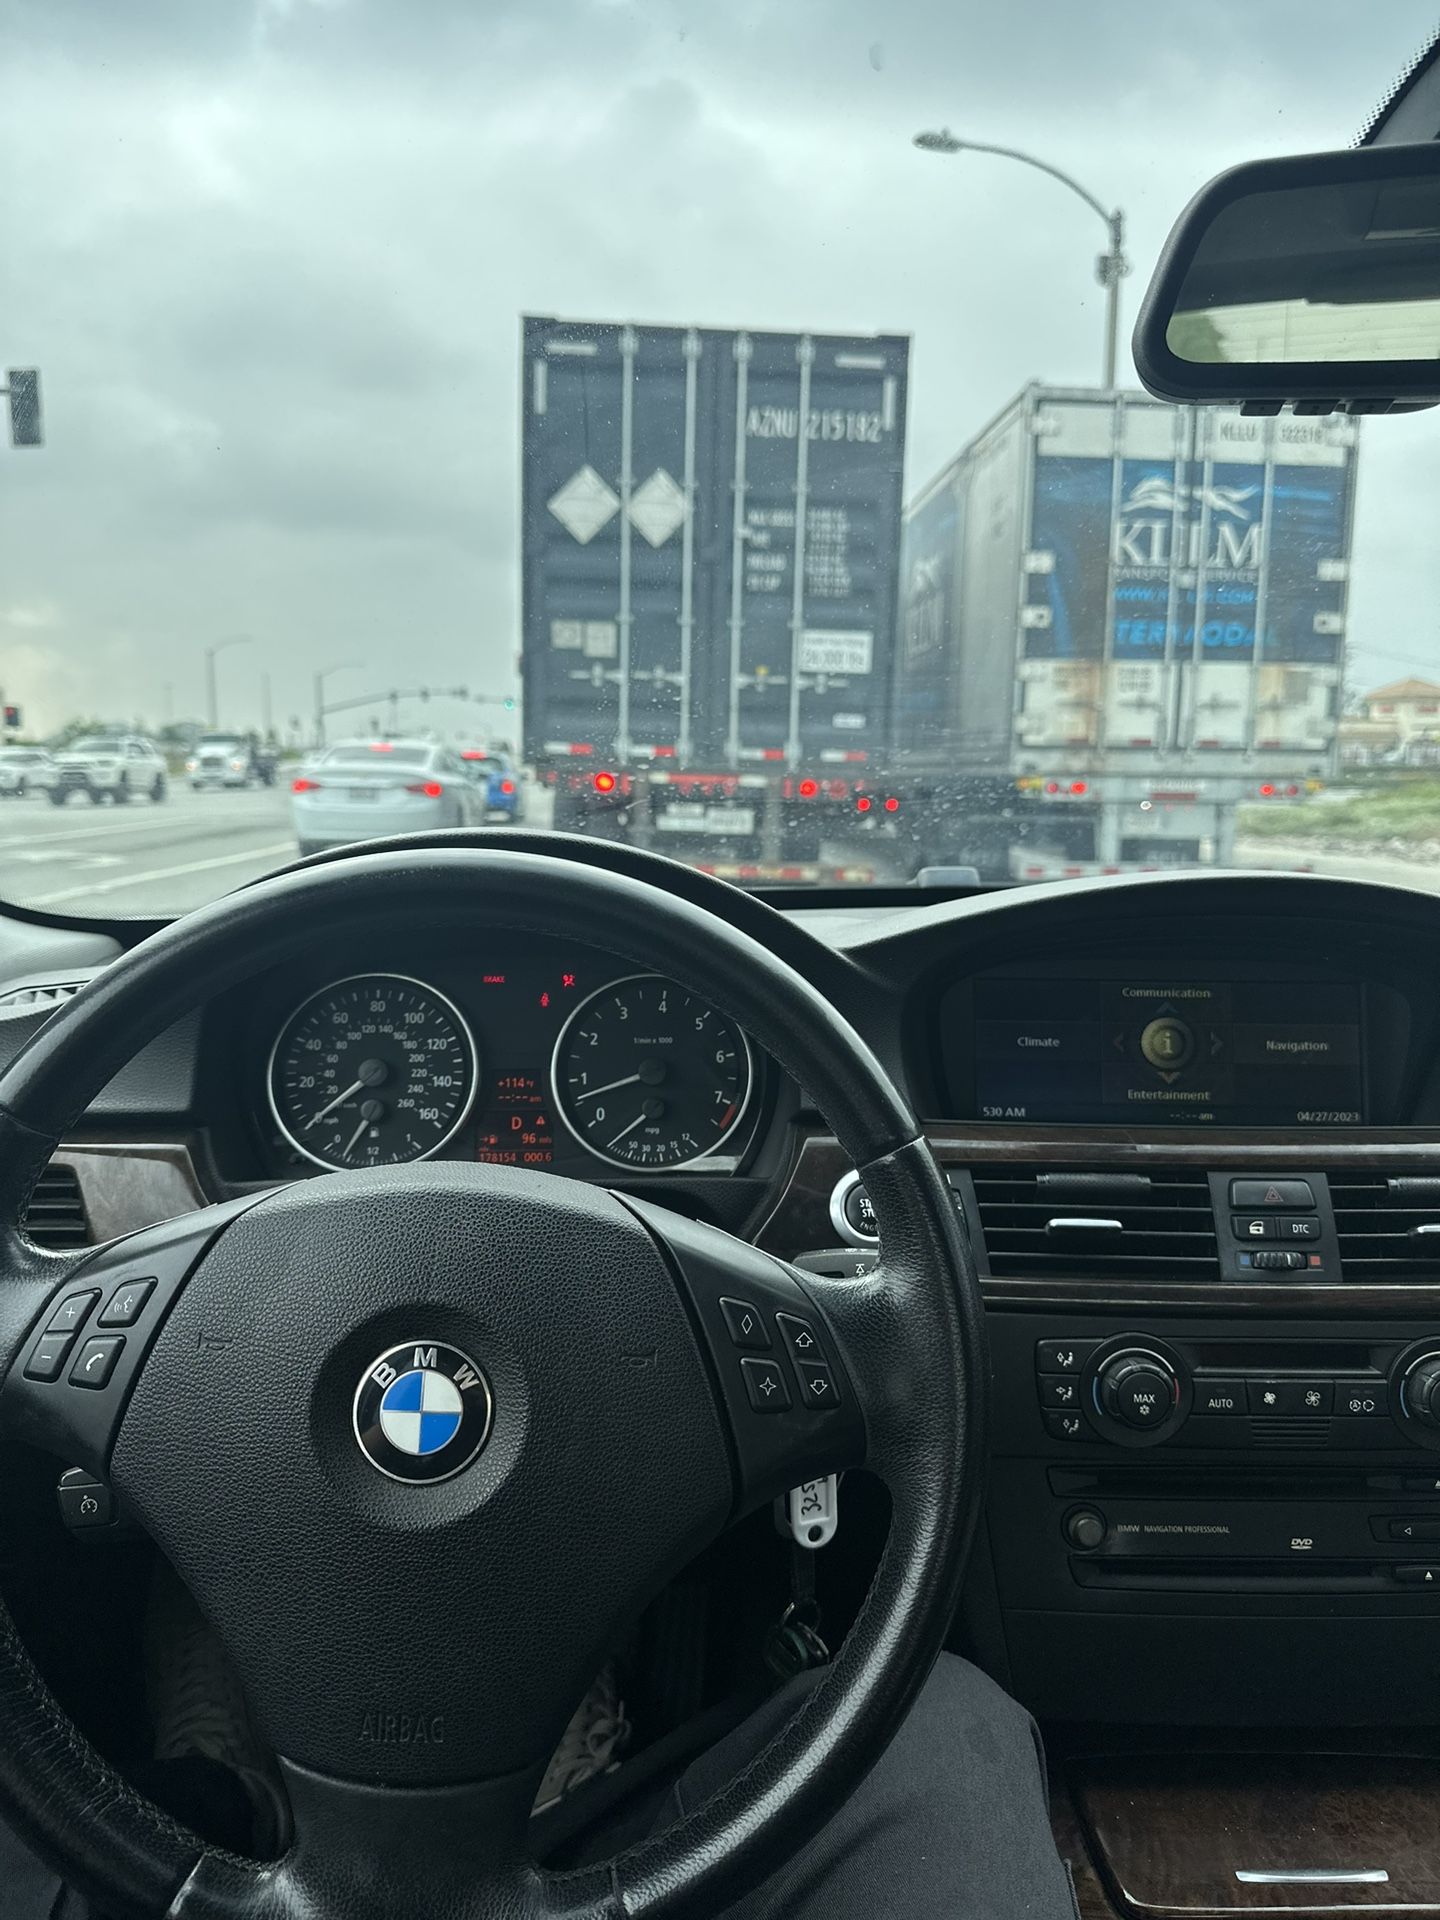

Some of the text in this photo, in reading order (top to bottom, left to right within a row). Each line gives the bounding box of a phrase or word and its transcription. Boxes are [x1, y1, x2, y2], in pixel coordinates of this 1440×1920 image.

[746, 405, 797, 438] AZNU
[1122, 987, 1211, 998] Communication
[370, 1001, 385, 1012] 80
[658, 1001, 667, 1013] 4
[333, 1013, 348, 1024] 60
[404, 1013, 424, 1024] 100
[620, 1007, 628, 1019] 3
[361, 1025, 376, 1034] 120
[379, 1025, 393, 1034] 140
[695, 1018, 703, 1030] 5
[348, 1032, 362, 1041] 100
[393, 1032, 407, 1040] 160
[590, 1033, 598, 1045] 2
[305, 1039, 322, 1051] 40
[336, 1041, 347, 1050] 80
[402, 1040, 417, 1049] 180
[427, 1038, 447, 1050] 120
[1017, 1036, 1060, 1048] Climate
[1266, 1039, 1329, 1053] Navigation
[327, 1054, 338, 1063] 60
[409, 1054, 425, 1063] 200
[716, 1051, 724, 1063] 6
[323, 1069, 335, 1078] 40
[411, 1069, 427, 1078] 220
[581, 1073, 587, 1085] 1
[300, 1076, 315, 1088] 20
[433, 1075, 452, 1087] 140
[327, 1085, 338, 1094] 20
[408, 1085, 424, 1094] 240
[1127, 1089, 1211, 1101] Entertainment
[715, 1091, 723, 1103] 7
[397, 1099, 414, 1108] 260
[419, 1108, 439, 1120] 160
[596, 1108, 605, 1120] 0
[1004, 1107, 1026, 1117] AM
[1296, 1111, 1360, 1123] 04/27/2023
[511, 1116, 522, 1130] D
[645, 1127, 660, 1136] mpg
[334, 1135, 341, 1143] 0
[522, 1133, 536, 1144] 96
[682, 1134, 690, 1142] 12
[367, 1146, 379, 1155] 1/2
[629, 1141, 638, 1149] 50
[642, 1144, 651, 1152] 30
[656, 1144, 665, 1152] 20
[670, 1141, 678, 1149] 15
[1292, 1223, 1310, 1235] DTC
[371, 1346, 480, 1391] BMW
[1133, 1393, 1156, 1404] MAX
[1207, 1397, 1234, 1409] AUTO
[1144, 1525, 1183, 1533] NAVIGATION
[1184, 1525, 1231, 1534] PROFESSIONAL
[1290, 1538, 1313, 1550] DVD
[359, 1712, 444, 1743] AIRBAG
